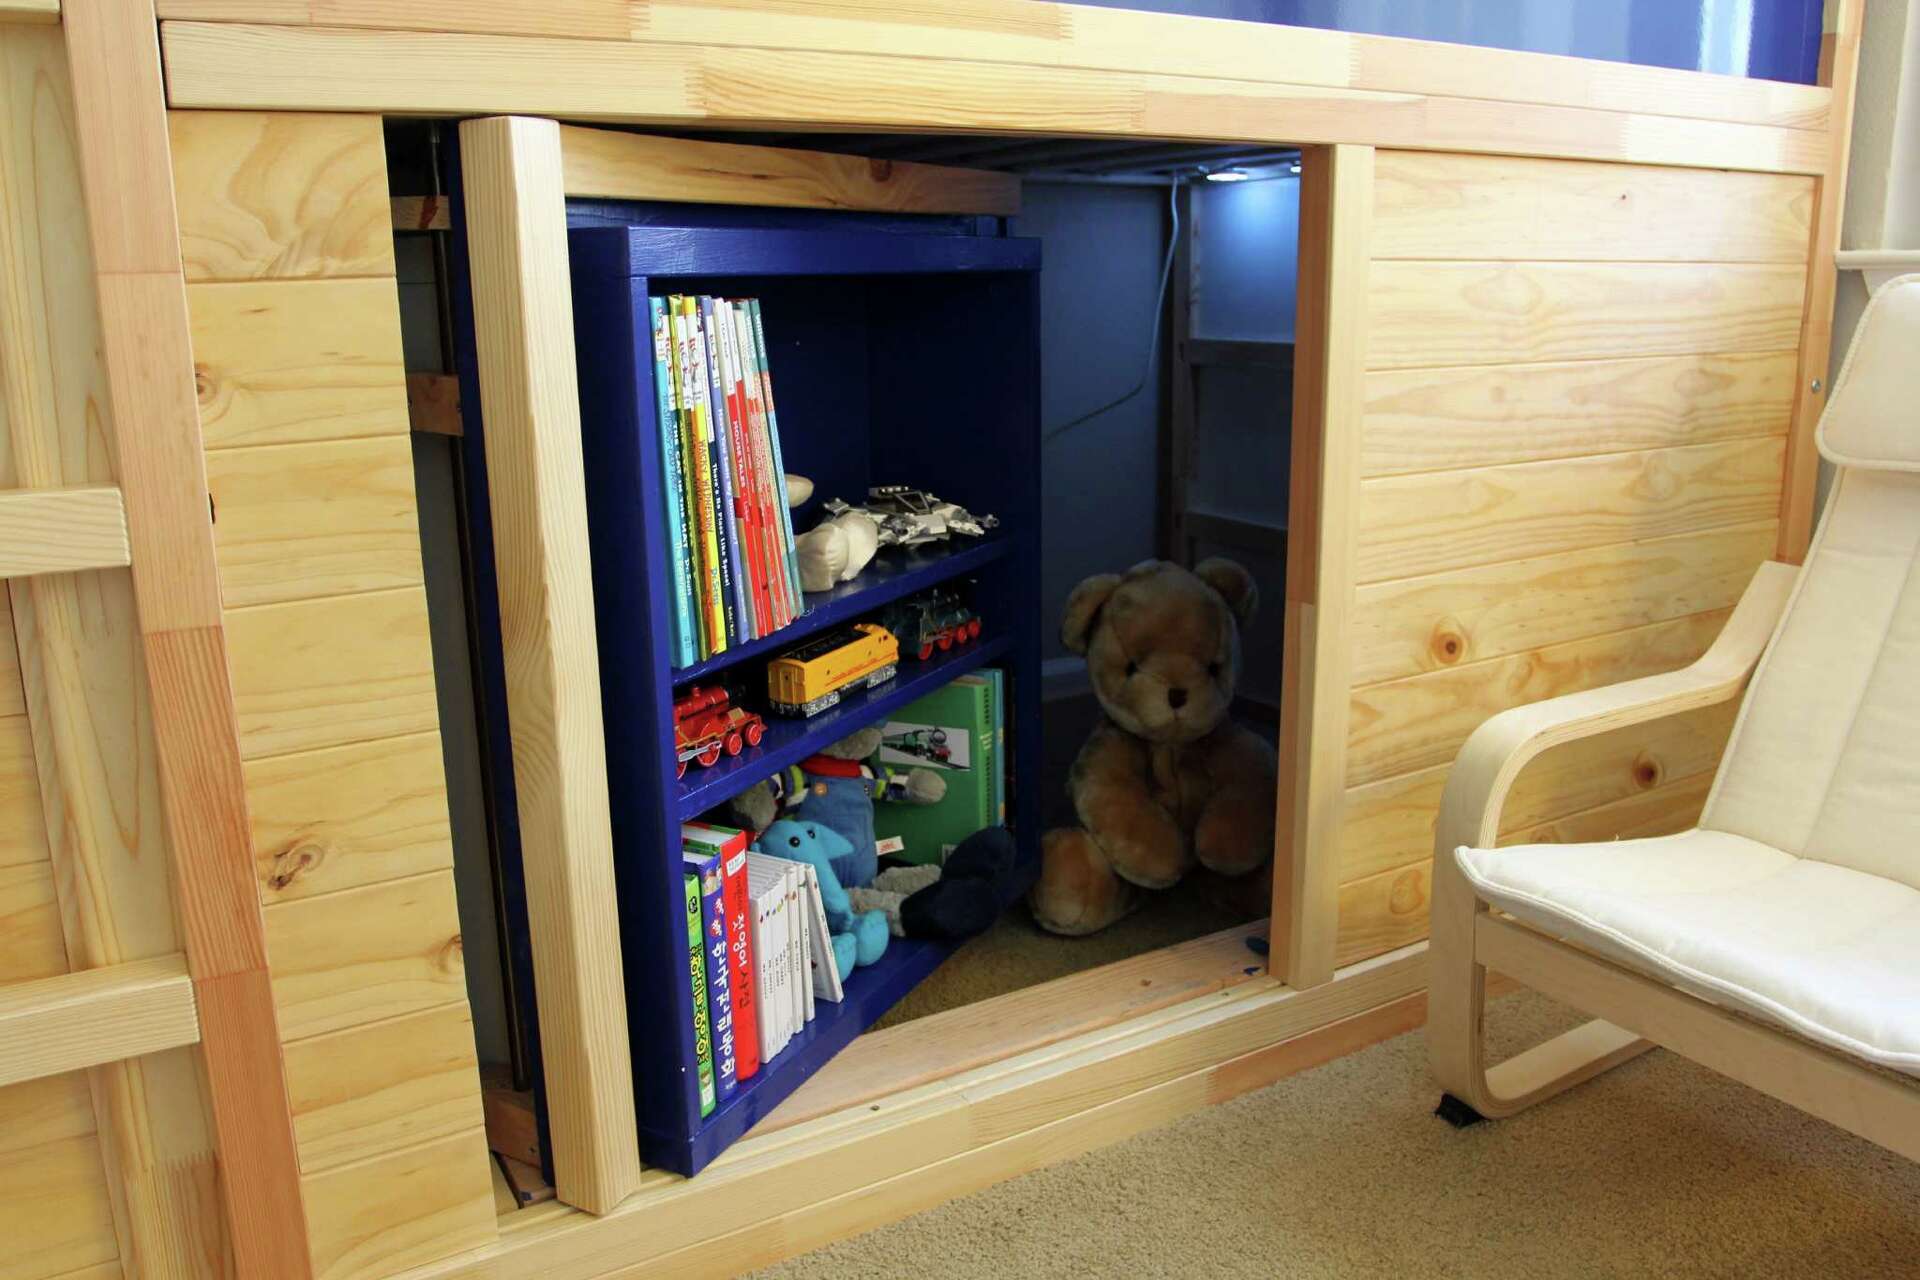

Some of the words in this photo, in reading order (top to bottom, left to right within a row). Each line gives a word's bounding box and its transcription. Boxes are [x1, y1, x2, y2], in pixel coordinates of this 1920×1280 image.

[712, 462, 720, 495] There's
[732, 420, 741, 456] MOUSE
[738, 457, 746, 488] TALES
[678, 479, 683, 493] IN
[681, 523, 689, 548] HAT
[715, 496, 721, 509] No
[722, 558, 730, 587] Space!
[711, 940, 736, 1079] 한국전래동화
